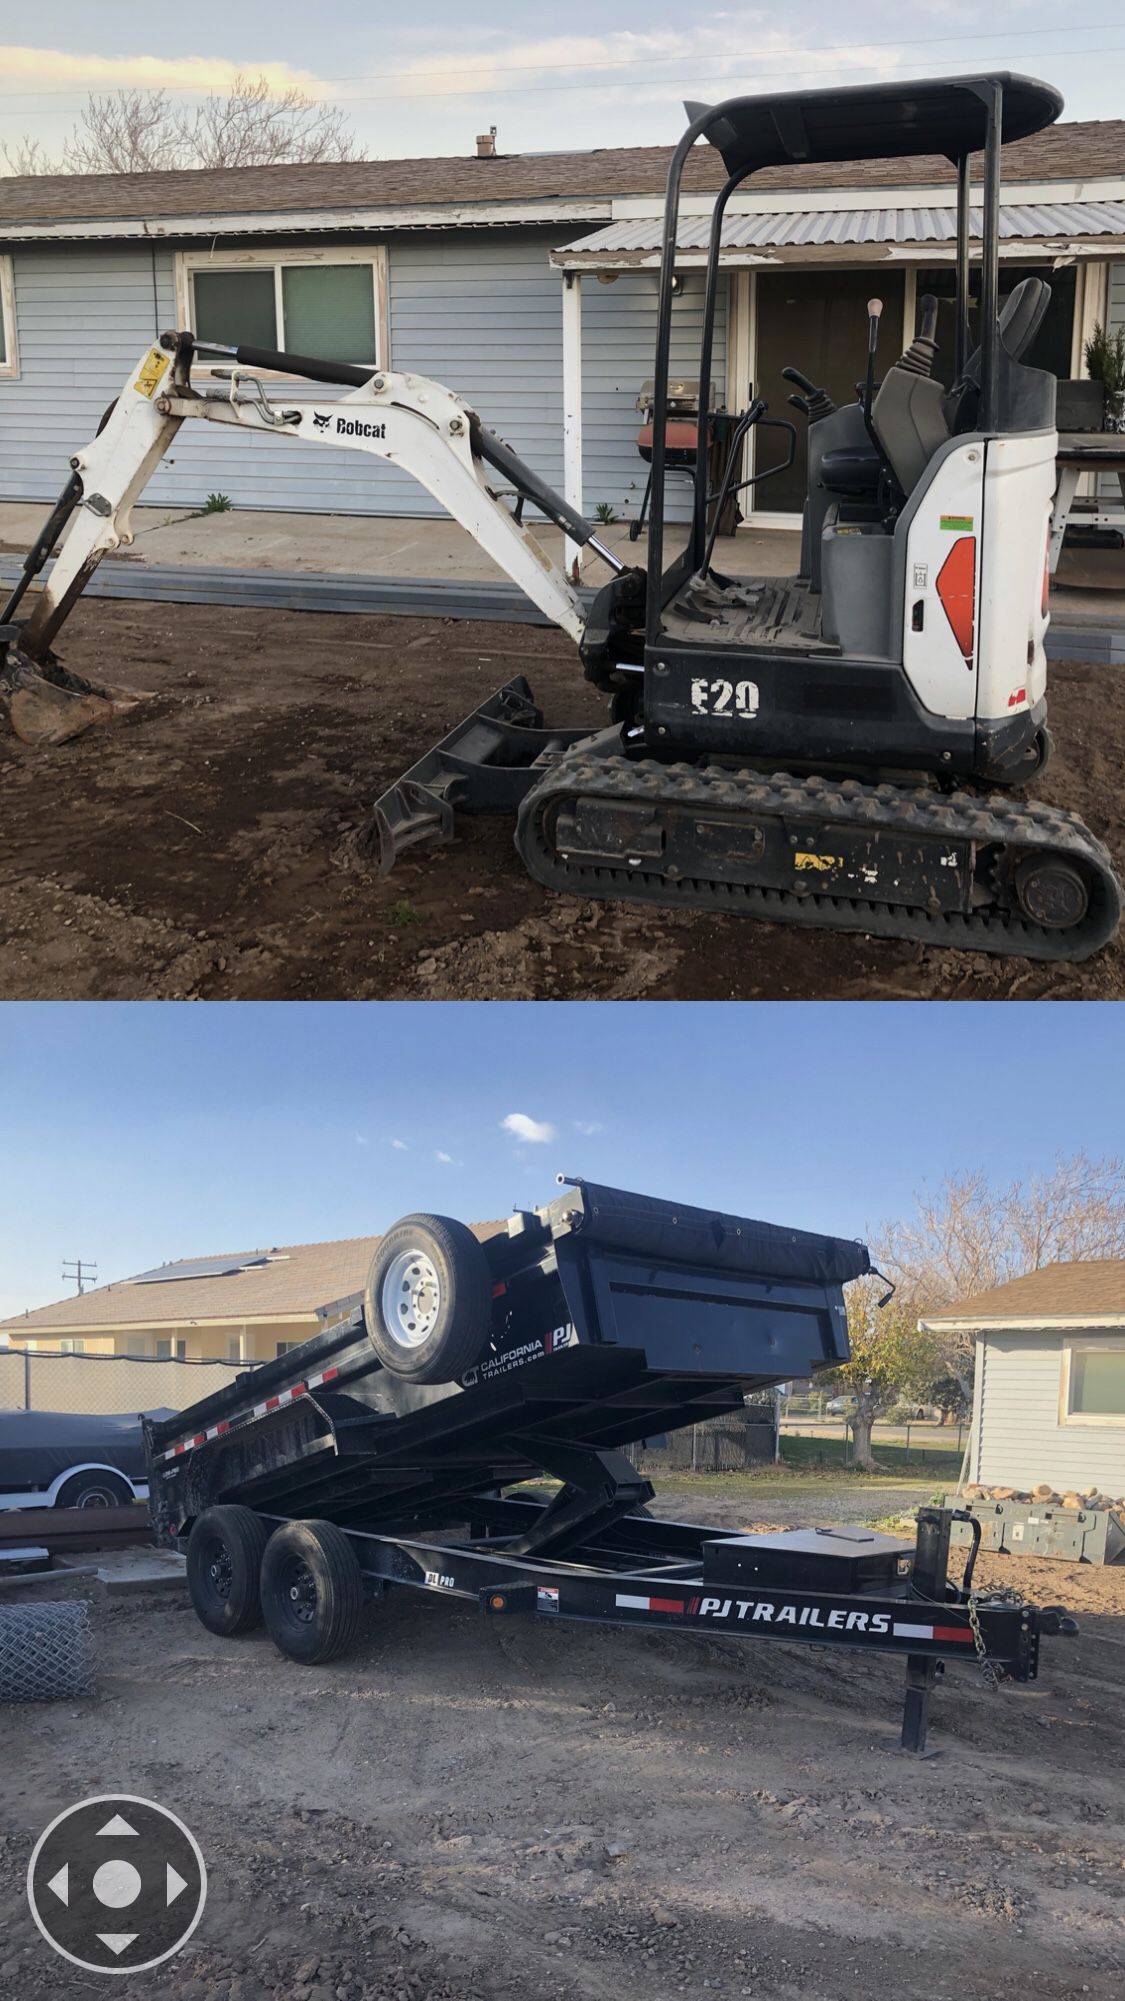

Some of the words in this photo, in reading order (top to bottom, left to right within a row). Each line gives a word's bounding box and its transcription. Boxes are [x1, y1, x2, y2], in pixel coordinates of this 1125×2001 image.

[336, 417, 386, 439] Bobcat
[690, 678, 760, 719] E20
[553, 1322, 572, 1347] PJ
[480, 1339, 543, 1372] CALIFORNIA
[482, 1350, 545, 1380] TRAILERS.com
[439, 1575, 455, 1588] PRO
[698, 1597, 733, 1618] PJ
[735, 1600, 892, 1634] TRAILERS
